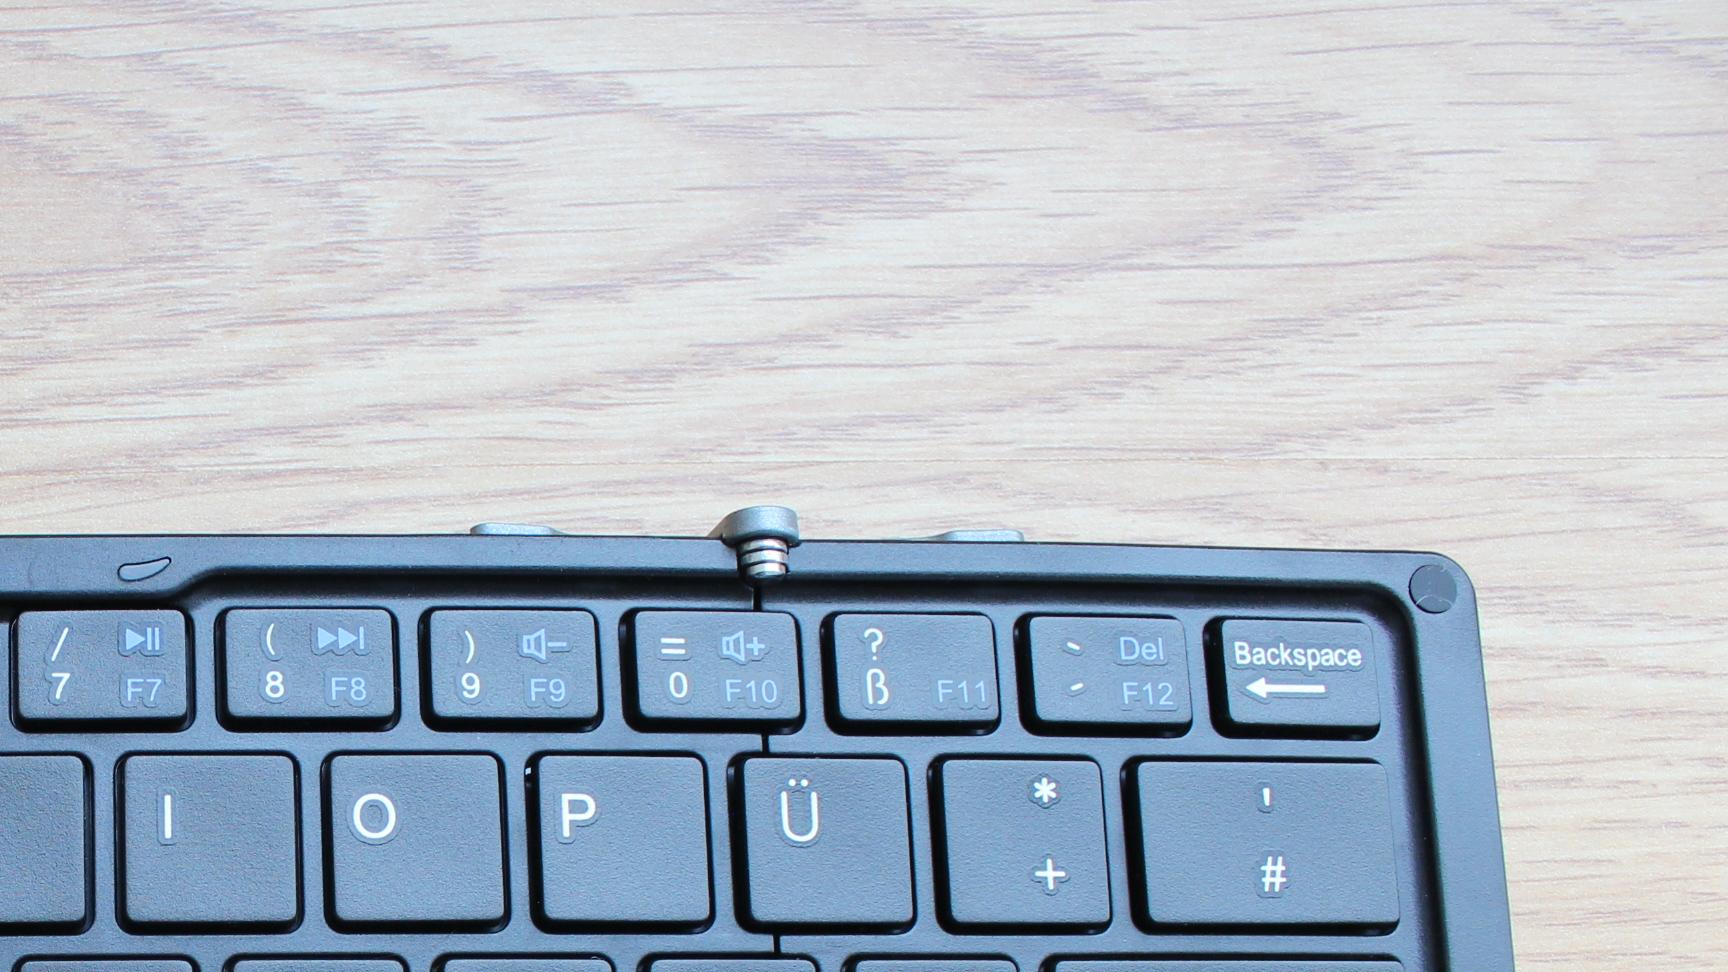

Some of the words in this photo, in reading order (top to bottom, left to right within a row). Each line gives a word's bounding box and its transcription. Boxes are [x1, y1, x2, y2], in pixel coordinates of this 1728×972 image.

[1119, 636, 1164, 661] Del
[1234, 641, 1363, 671] Backspace
[51, 672, 71, 700] 7
[127, 678, 162, 702] F7
[265, 670, 285, 698] 8
[331, 676, 367, 701] F8
[461, 672, 481, 699] 9
[530, 678, 566, 702] F9
[669, 671, 688, 698] 0
[725, 679, 778, 704] F10
[937, 679, 986, 703] F11
[1122, 681, 1174, 705] F12
[352, 793, 396, 839] O
[561, 793, 596, 838] P
[780, 778, 819, 842] Ü
